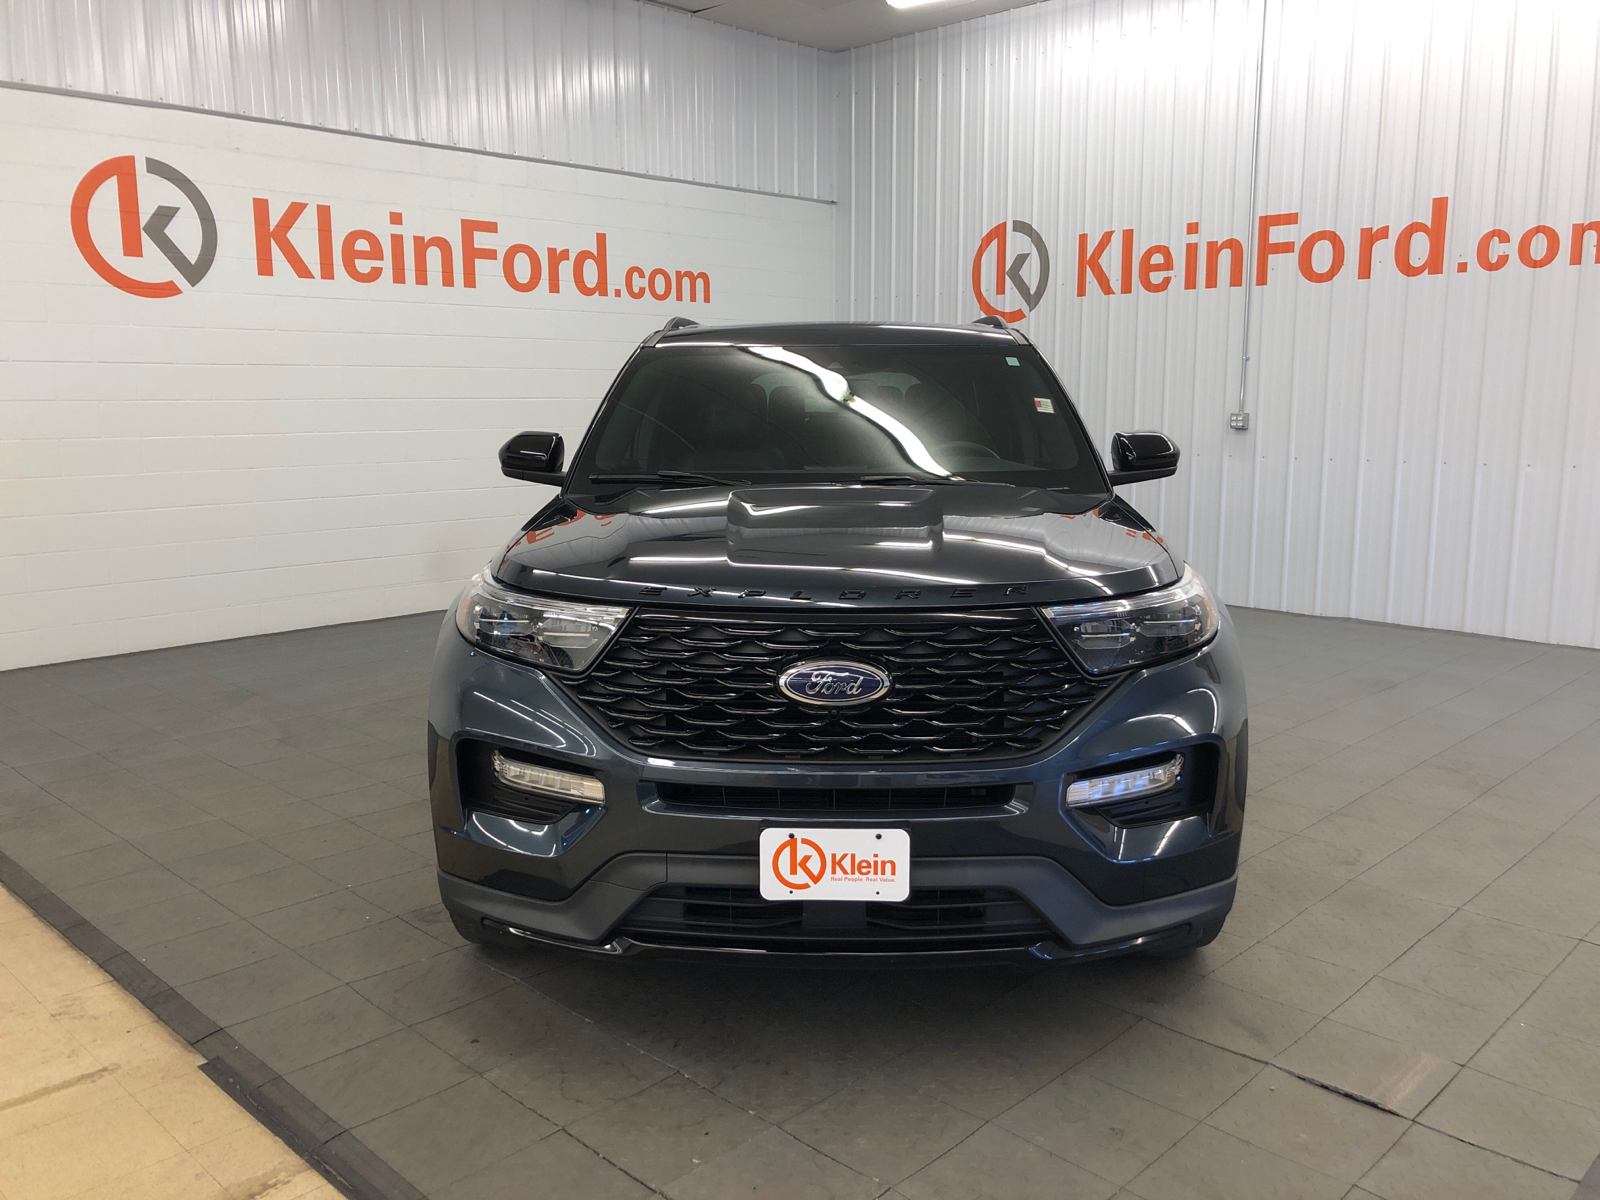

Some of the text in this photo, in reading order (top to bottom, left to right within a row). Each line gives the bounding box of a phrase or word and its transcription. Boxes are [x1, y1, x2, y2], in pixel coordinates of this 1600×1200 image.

[252, 197, 711, 304] KleinFord.com
[637, 584, 1029, 601] EXPLORER
[804, 670, 864, 695] Ford
[831, 853, 897, 876] Klein
